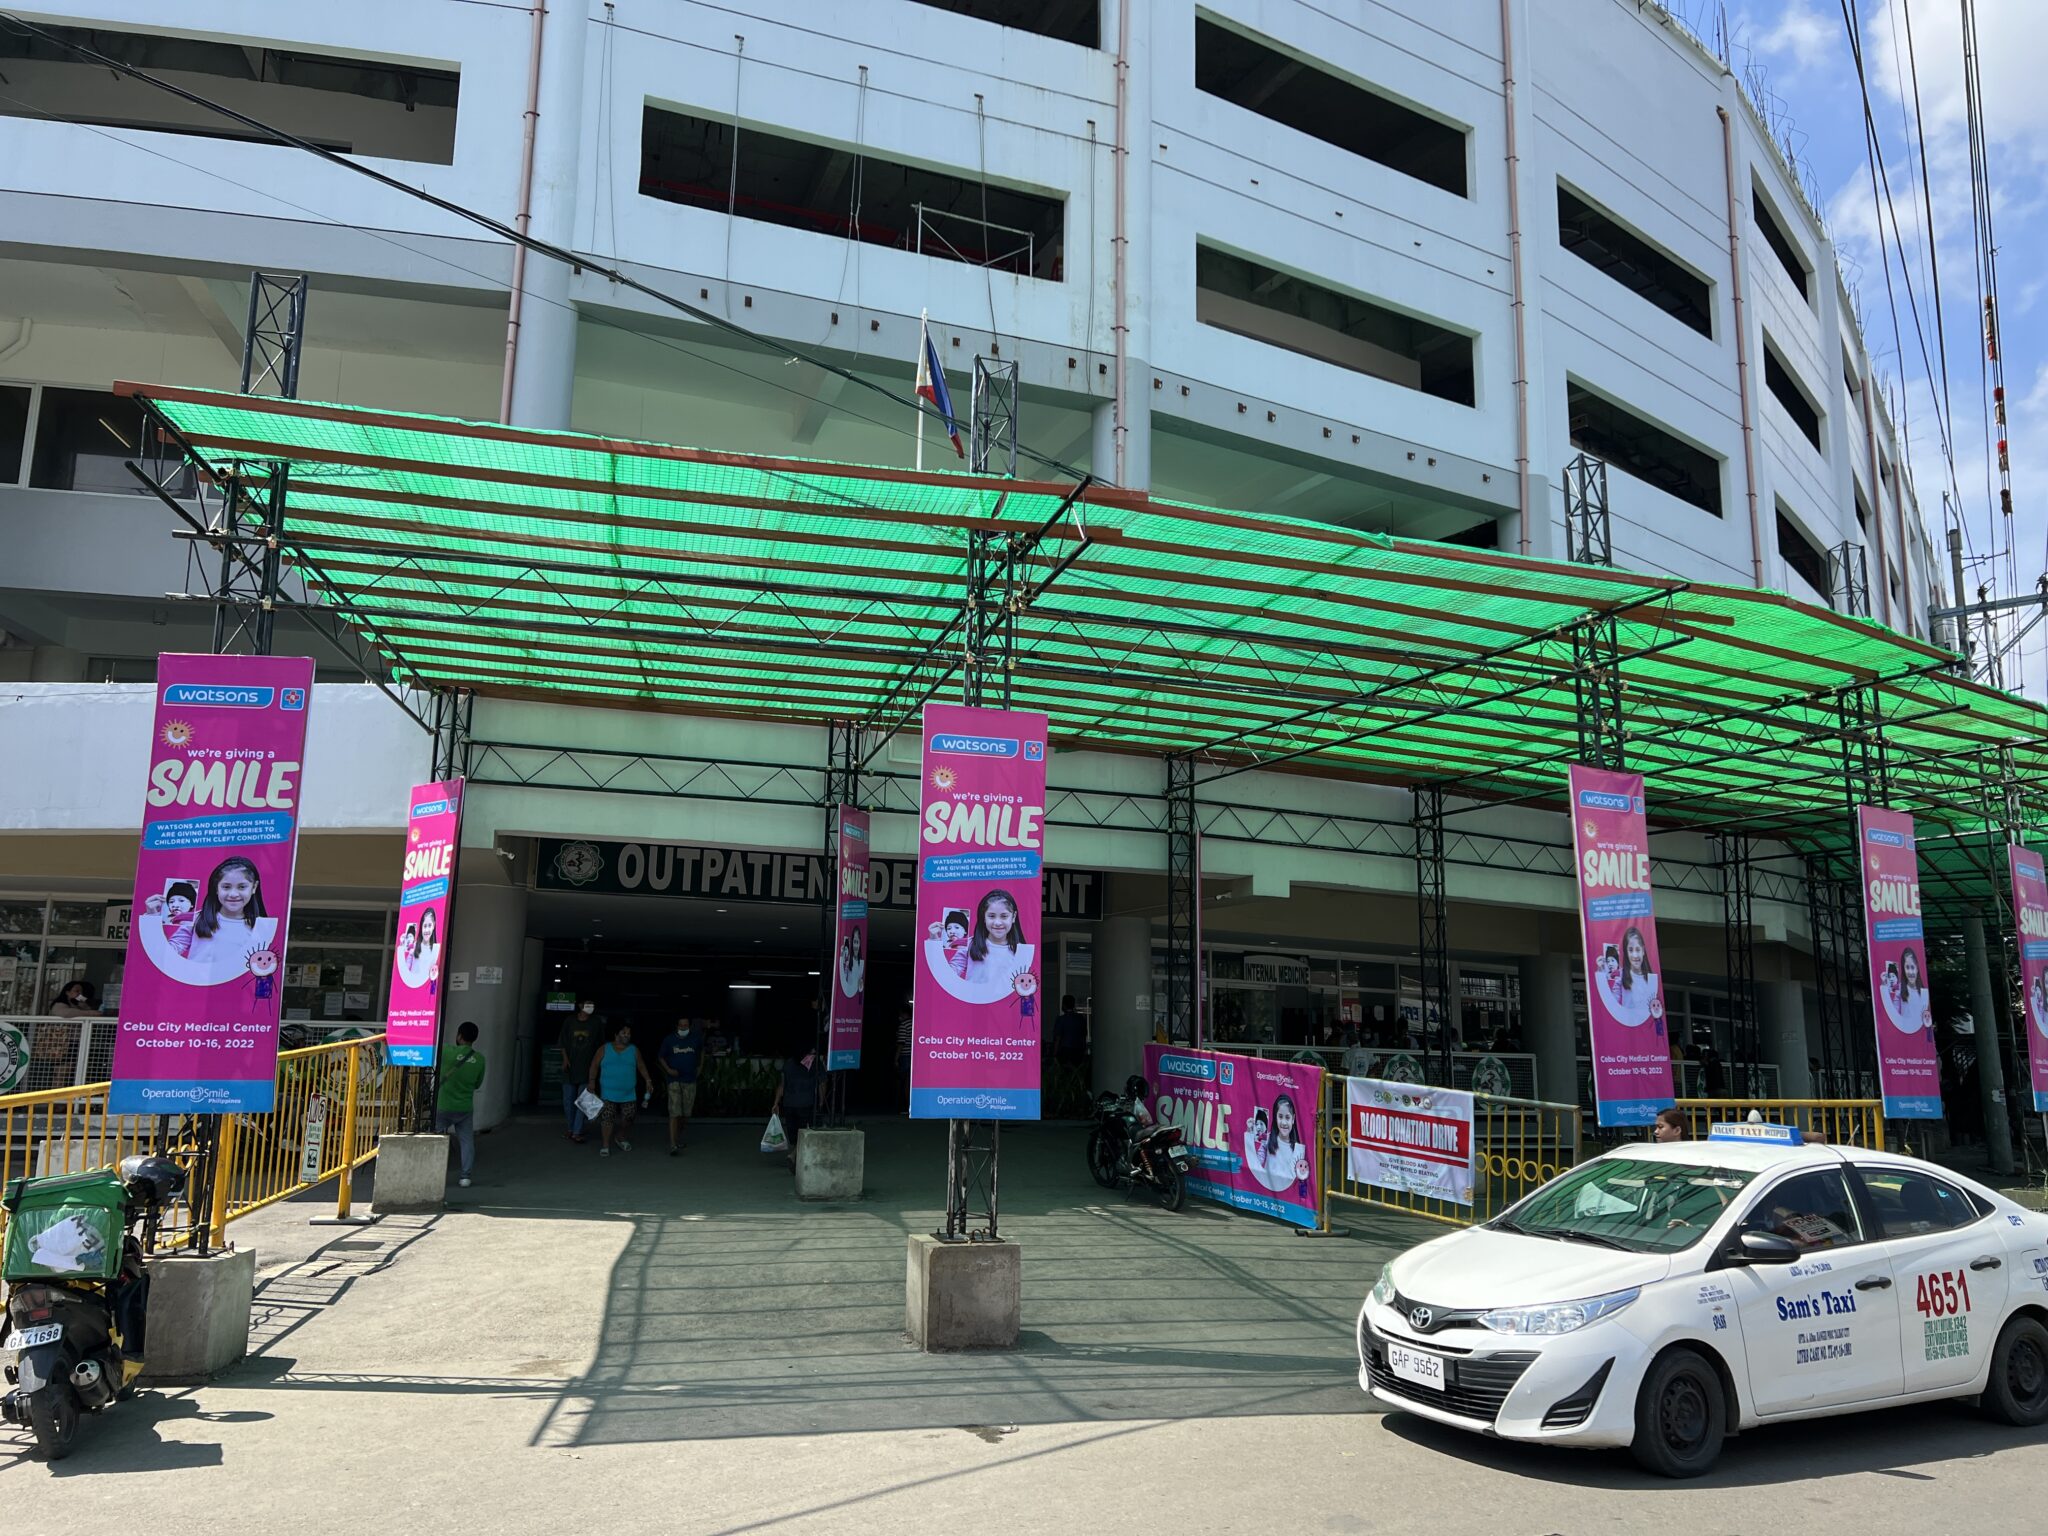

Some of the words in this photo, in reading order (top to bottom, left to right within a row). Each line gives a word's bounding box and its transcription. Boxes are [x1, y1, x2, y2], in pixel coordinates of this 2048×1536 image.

[179, 689, 258, 703] watsons
[942, 738, 1007, 753] watsons
[187, 749, 221, 758] we're
[225, 749, 264, 760] giving
[147, 759, 300, 809] SMILE
[953, 792, 981, 801] we're
[983, 794, 1014, 803] giving
[1586, 794, 1624, 808] watsons
[416, 804, 442, 815] watsons
[157, 823, 193, 831] WATSONS
[212, 820, 253, 828] OPERATION
[923, 801, 1043, 848] SMILE
[155, 838, 191, 846] CHILDREN
[403, 844, 453, 881] SMILE
[1583, 849, 1650, 890] SMILE
[617, 843, 838, 900] OUTPATIEN
[842, 867, 868, 899] SMILE
[1870, 879, 1921, 916] SMILE
[1246, 963, 1277, 982] INTERNAL
[1279, 964, 1309, 984] MEDICINE
[123, 1022, 154, 1031] Cebu
[158, 1022, 181, 1034] City
[185, 1022, 229, 1032] Medical
[233, 1023, 272, 1033] Center
[136, 1038, 185, 1048] October
[188, 1039, 221, 1049] 10-16,
[225, 1039, 255, 1048] 2022
[919, 1036, 942, 1044] Cebu
[946, 1036, 964, 1046] City
[967, 1037, 1003, 1046] Medical
[1006, 1038, 1036, 1046] Center
[929, 1051, 968, 1060] October
[971, 1051, 997, 1061] 10-16,
[1000, 1052, 1024, 1060] 2022
[1616, 1055, 1628, 1063] City
[1167, 1060, 1209, 1076] watsons
[1256, 1072, 1277, 1083] Operation
[142, 1088, 190, 1100] Operation
[204, 1088, 230, 1098] Smile
[1174, 1086, 1192, 1097] we're
[1193, 1088, 1214, 1099] giving
[937, 1095, 976, 1106] Operation
[986, 1096, 1006, 1105] Smile
[1156, 1095, 1232, 1152] SMILE
[1360, 1112, 1387, 1140] BLOOD
[1388, 1116, 1430, 1148] DONATION
[1432, 1123, 1459, 1152] DRIVE
[1714, 1126, 1735, 1135] VACANT
[1741, 1127, 1762, 1136] TAXI
[1764, 1128, 1788, 1138] OCCUPIED
[1400, 1159, 1417, 1167] BLOOD
[1400, 1166, 1417, 1174] WORLD
[1917, 1269, 1971, 1318] 4651
[1776, 1294, 1820, 1321] Sam's
[1821, 1289, 1857, 1315] Taxi
[1954, 1315, 1968, 1330] 1342
[1391, 1350, 1409, 1369] GAP
[1414, 1357, 1439, 1378] 9562
